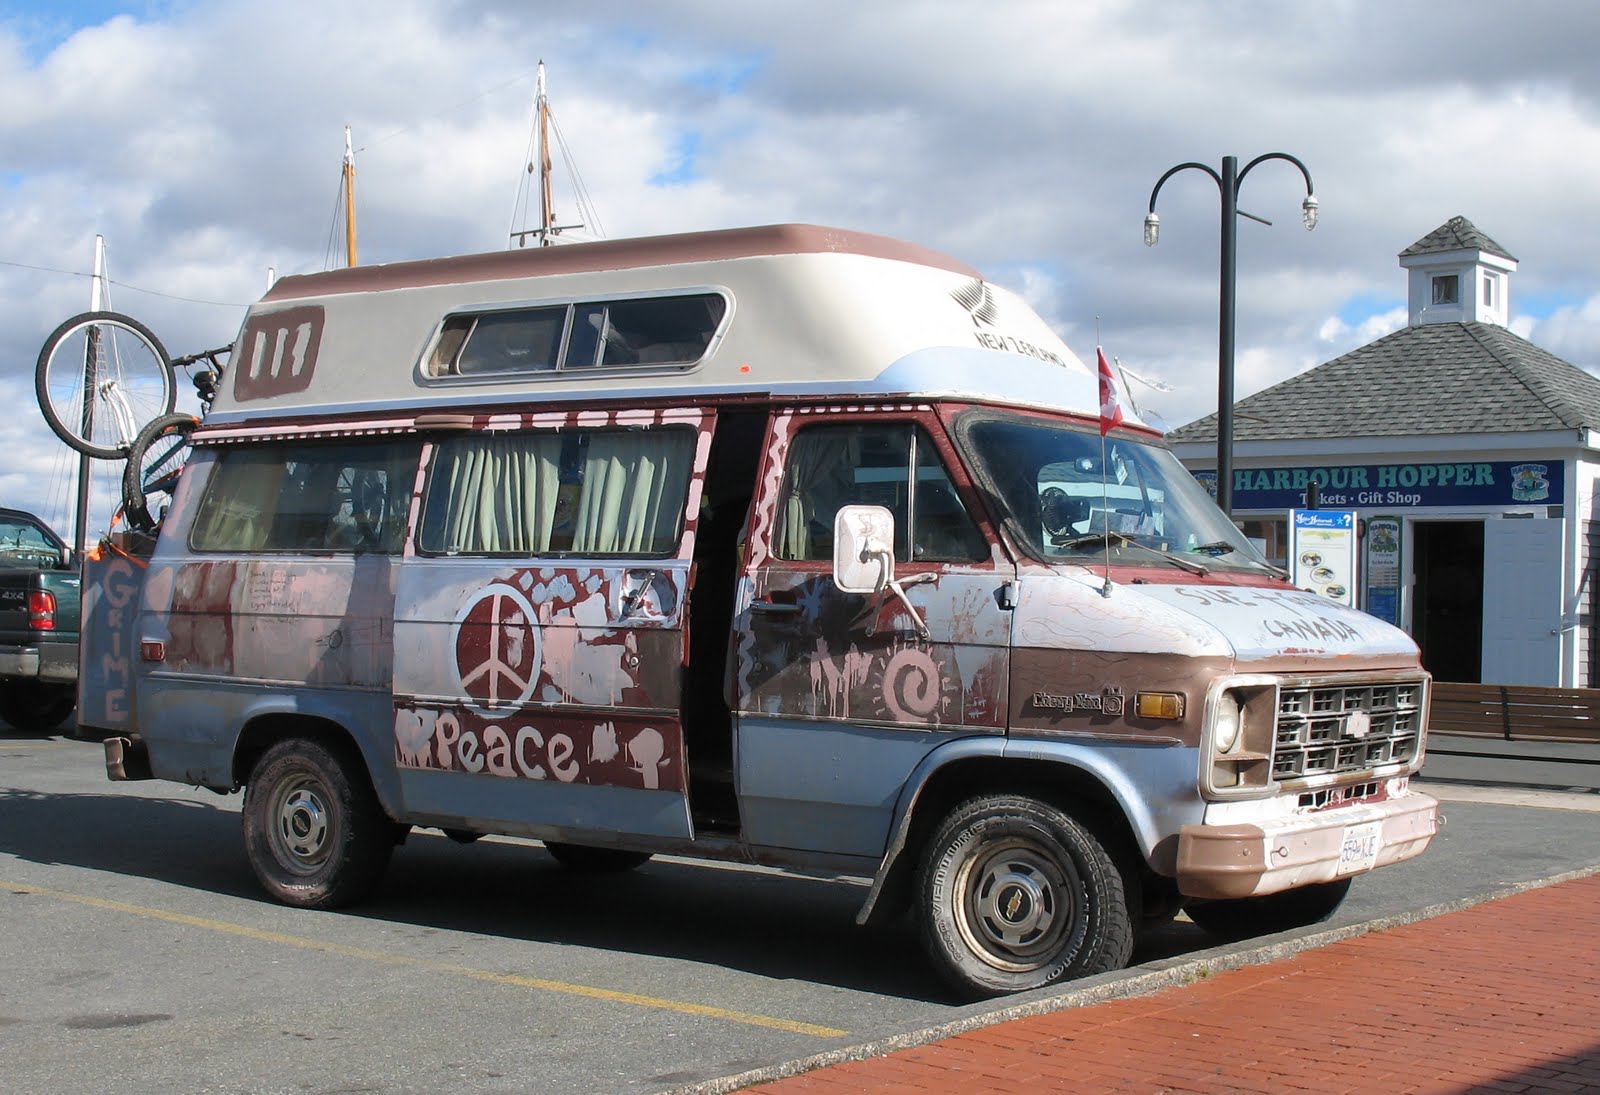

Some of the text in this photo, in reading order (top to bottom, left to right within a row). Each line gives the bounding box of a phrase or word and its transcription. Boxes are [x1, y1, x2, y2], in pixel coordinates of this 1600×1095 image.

[974, 331, 1010, 351] NEW
[1233, 467, 1370, 490] HARBOUR
[1377, 463, 1495, 488] HOPPER
[1300, 491, 1422, 506] Tkets Gift Shop
[1175, 587, 1258, 606] SUE
[1263, 617, 1365, 641] CANADA
[435, 712, 580, 783] Peace
